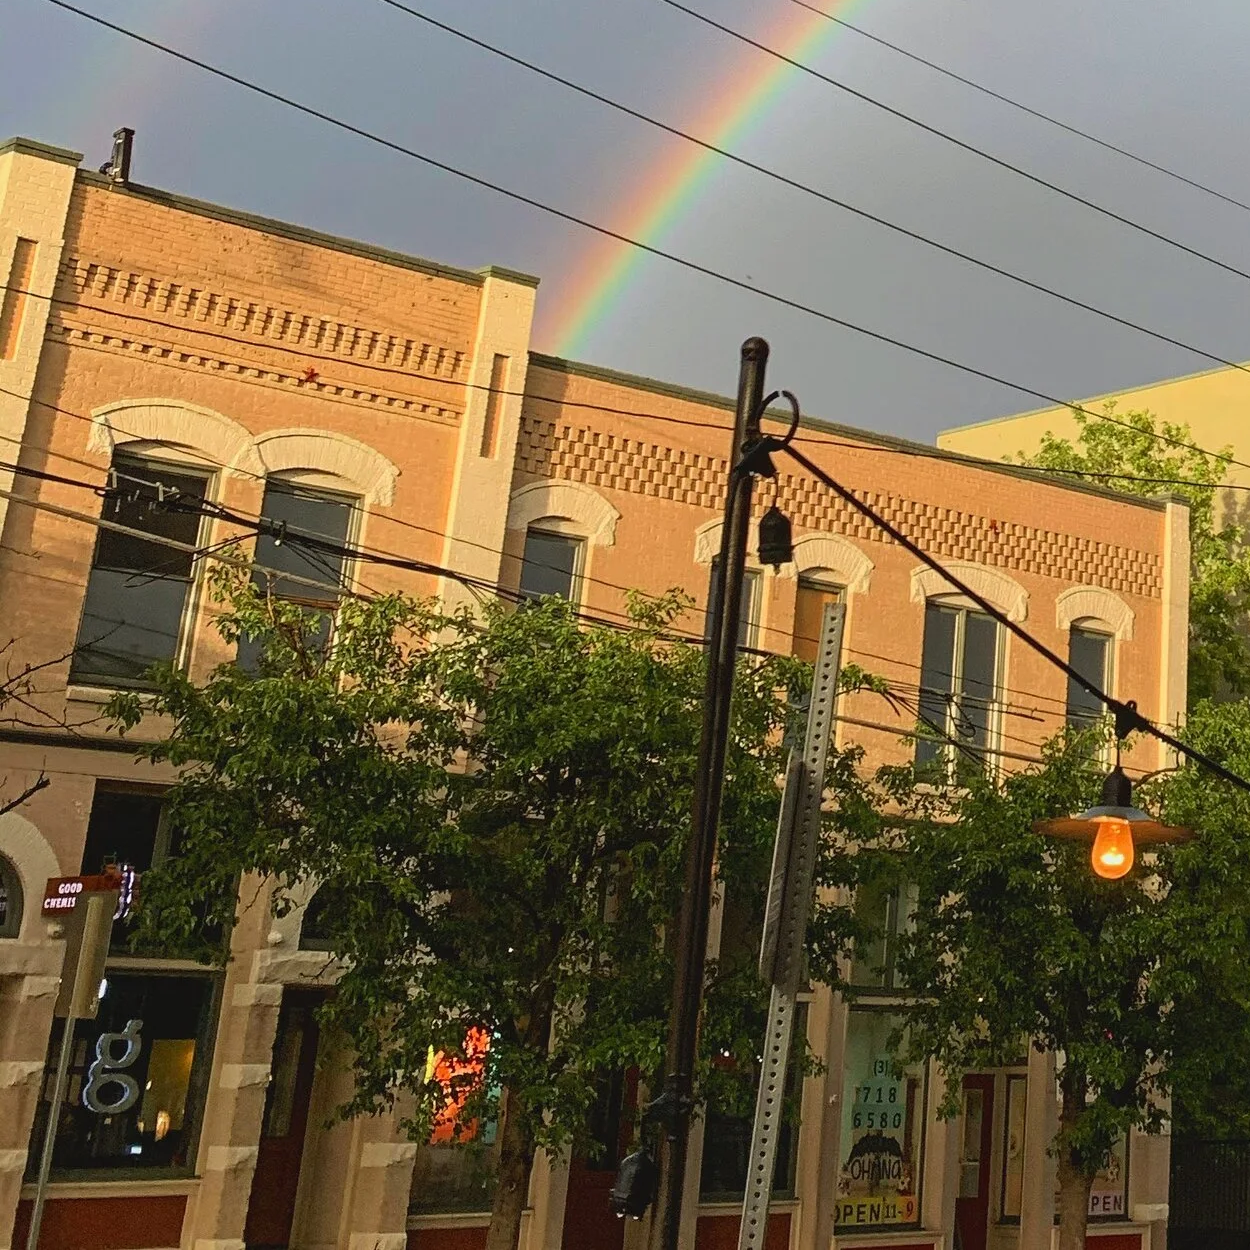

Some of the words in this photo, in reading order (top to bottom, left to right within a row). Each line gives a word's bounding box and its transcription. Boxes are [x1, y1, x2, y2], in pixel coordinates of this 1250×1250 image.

[58, 882, 83, 894] GOOD
[863, 1086, 897, 1103] 718
[853, 1112, 902, 1129] 6580
[1090, 1195, 1123, 1212] PEN
